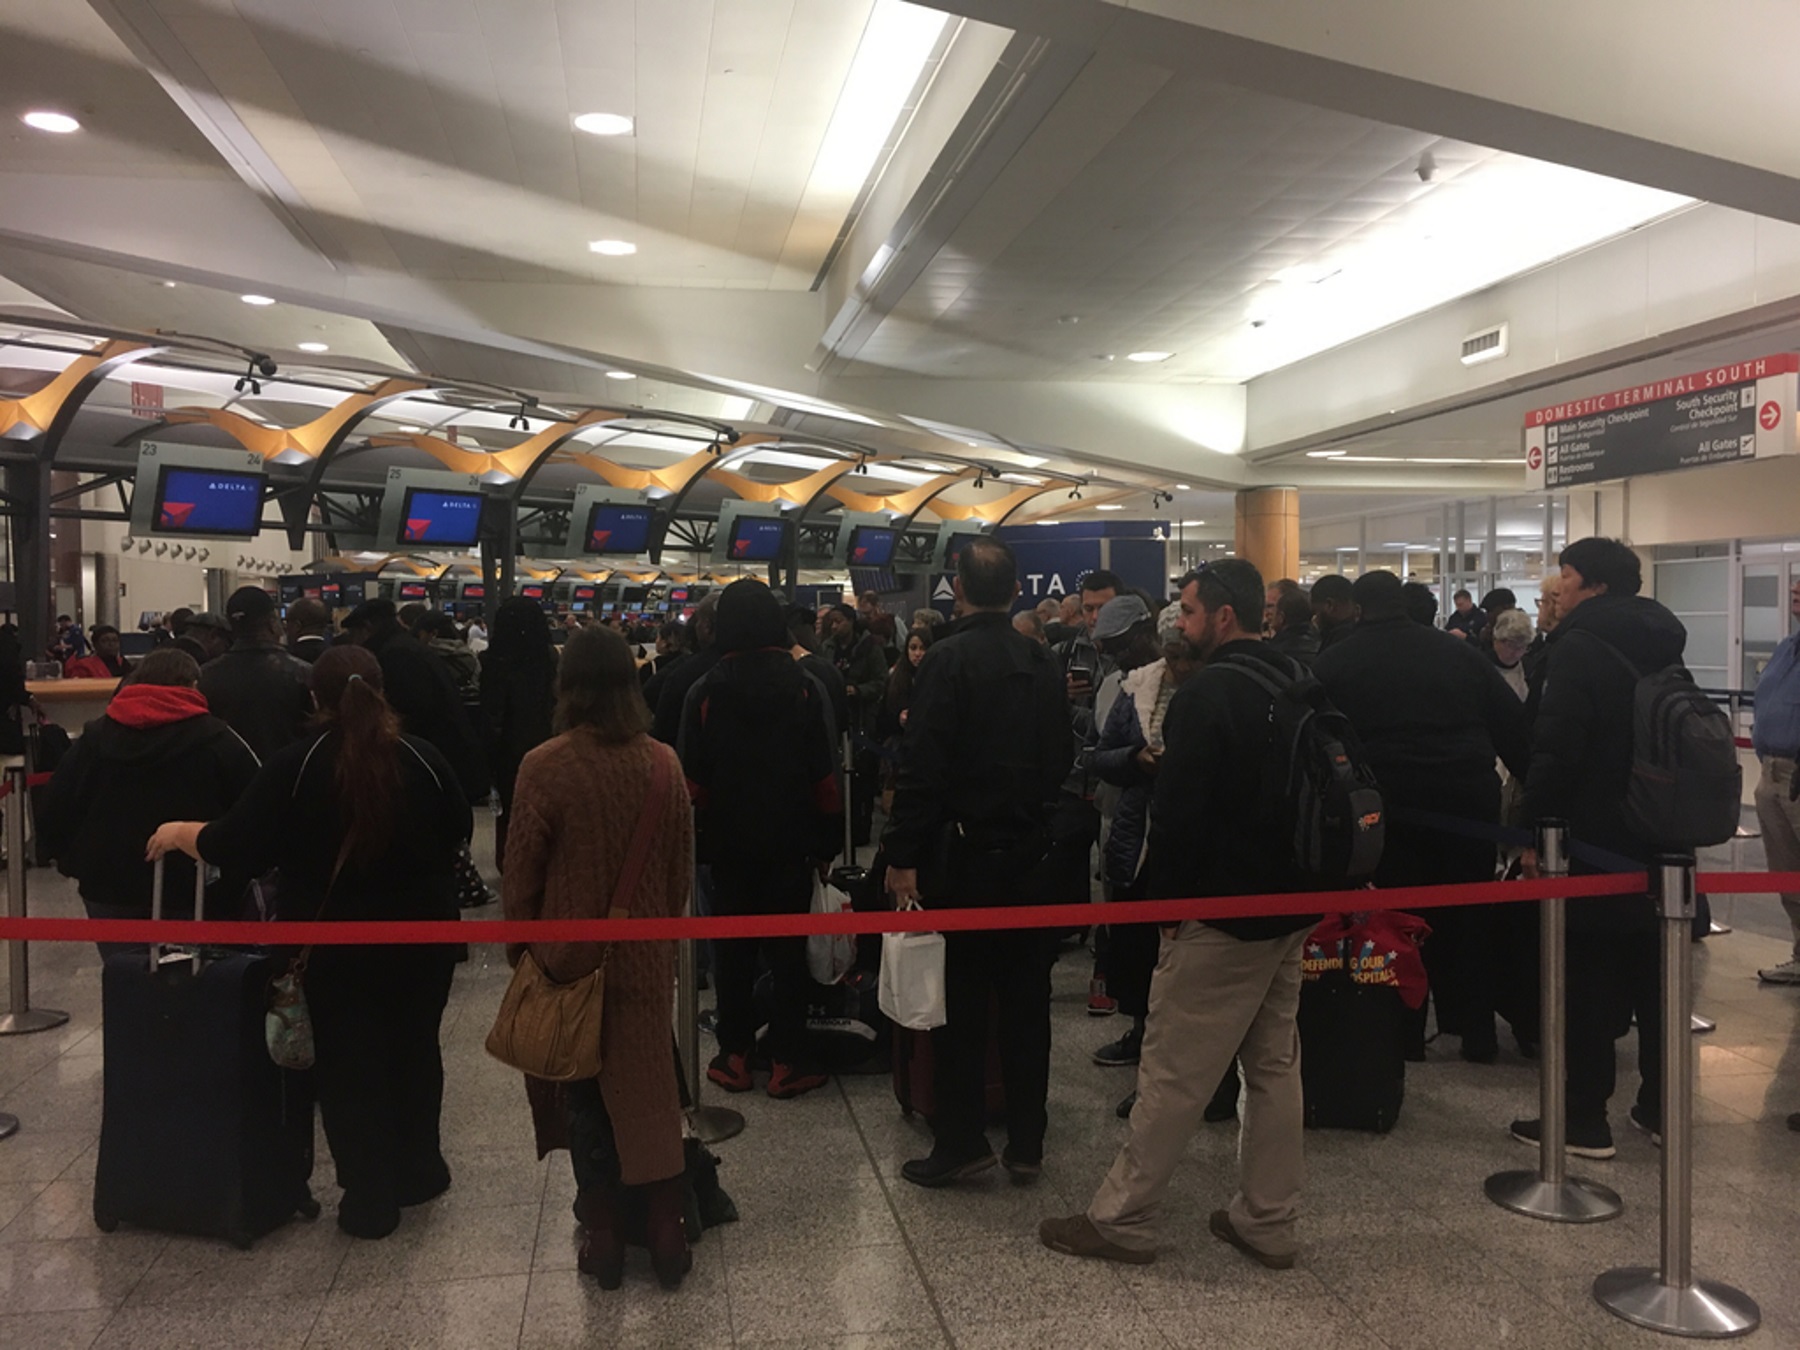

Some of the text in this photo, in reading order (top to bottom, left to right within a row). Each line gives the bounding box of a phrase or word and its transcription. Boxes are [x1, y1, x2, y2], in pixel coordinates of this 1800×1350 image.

[1535, 360, 1767, 424] DOMESTIC TERMINAL SOUTH
[1676, 389, 1739, 411] South Security
[1688, 402, 1738, 419] Checkpoint
[1559, 407, 1650, 434] Main Security Checkpoint
[142, 443, 157, 456] 23
[1560, 442, 1590, 454] All Gates
[1698, 438, 1738, 453] All Gates
[247, 453, 261, 465] 24
[389, 469, 402, 479] 25
[1559, 462, 1595, 475] Restrooms
[217, 482, 247, 491] DELTA
[449, 501, 471, 509] DELTA
[1360, 954, 1385, 969] OUR
